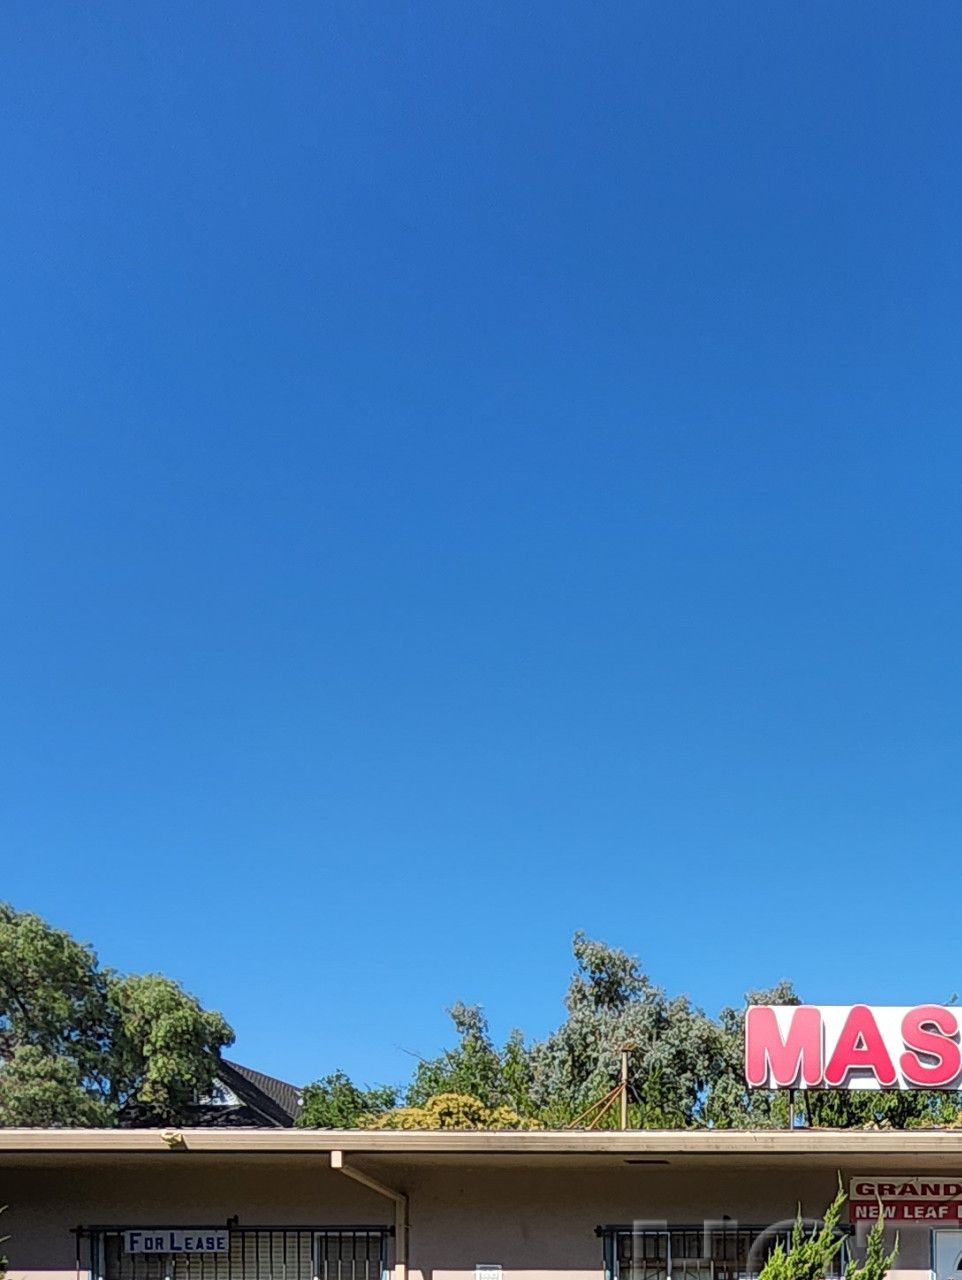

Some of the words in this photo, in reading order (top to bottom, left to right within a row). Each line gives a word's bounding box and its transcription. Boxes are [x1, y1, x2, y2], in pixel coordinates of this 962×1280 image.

[855, 1183, 962, 1196] GRAND
[855, 1205, 896, 1219] NEW
[903, 1205, 949, 1219] LEAF
